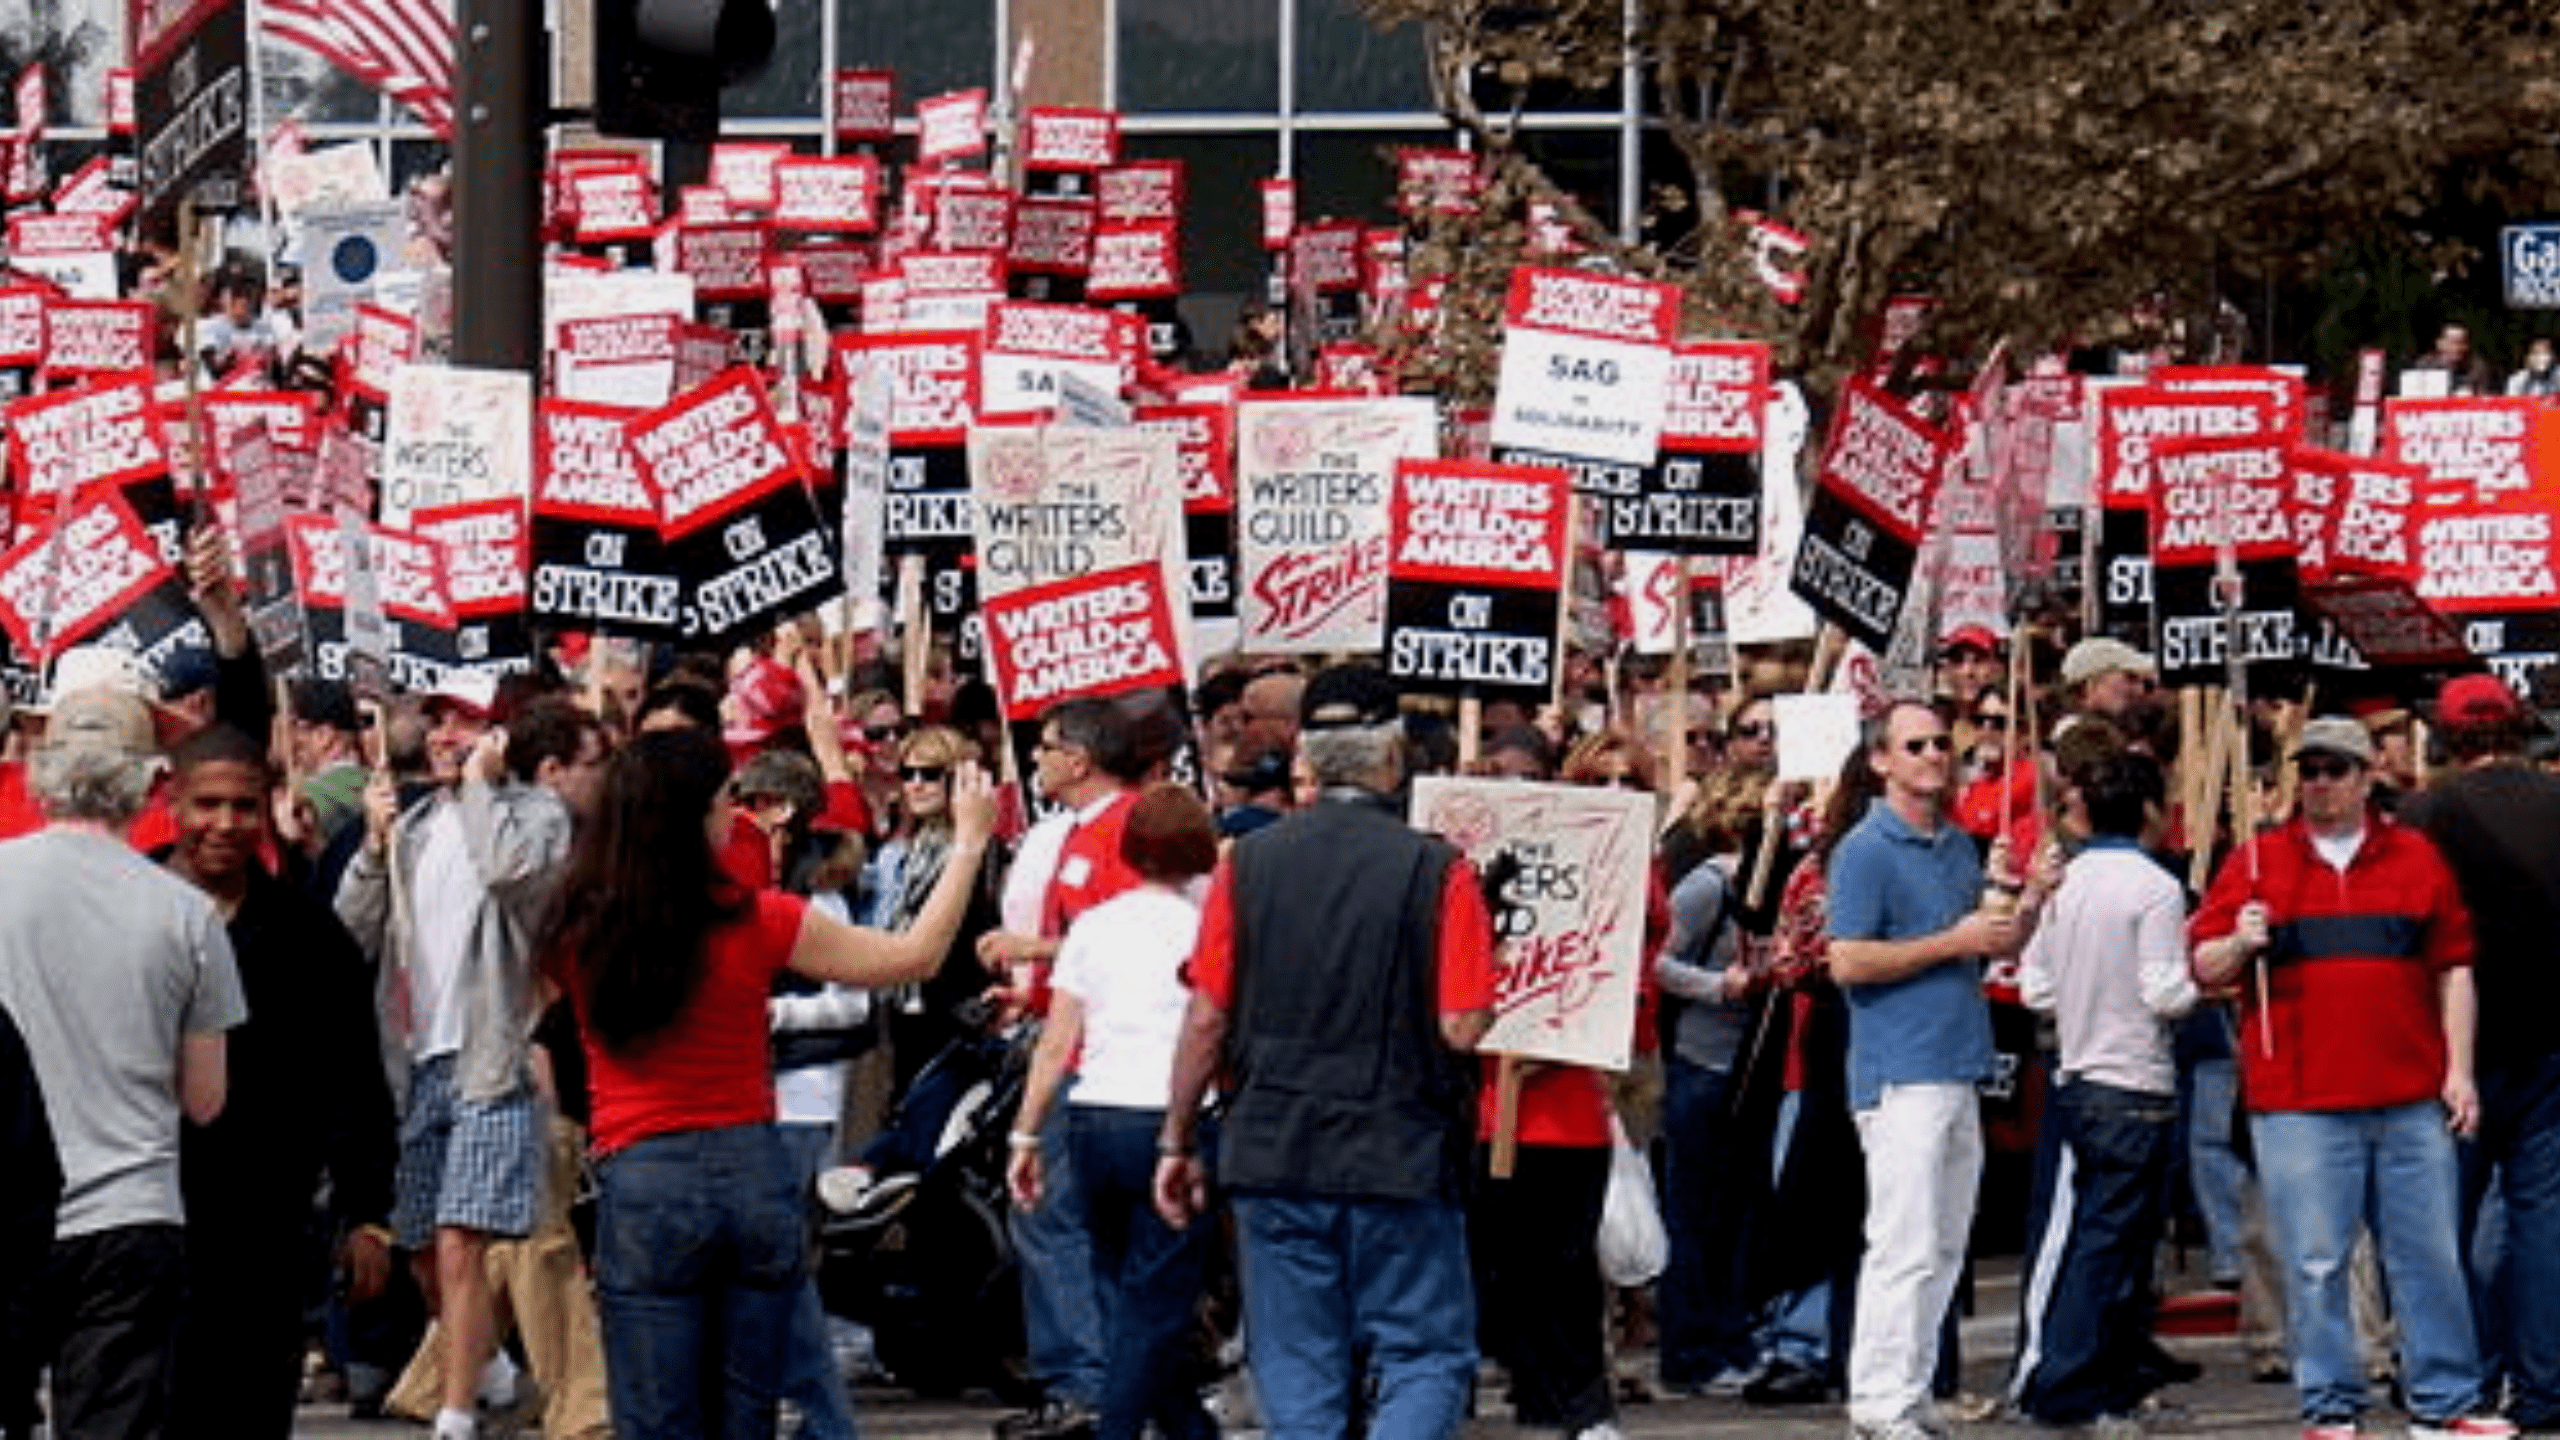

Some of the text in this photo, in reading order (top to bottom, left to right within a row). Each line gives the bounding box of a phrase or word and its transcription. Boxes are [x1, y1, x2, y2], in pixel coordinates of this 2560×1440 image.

[1017, 369, 1055, 392] SA
[1548, 355, 1620, 386] SAG
[634, 384, 757, 462] WRITERS
[2111, 405, 2258, 436] WRITERS
[2396, 409, 2525, 438] WRITERS
[2401, 438, 2487, 465] GUILD
[1250, 472, 1380, 506] WRITERS
[1402, 473, 1551, 514] WRITERS
[1665, 461, 1703, 490] ON
[888, 493, 975, 537] RIKE
[986, 503, 1125, 541] WRITERS
[1249, 508, 1351, 545] GUILD
[1409, 506, 1512, 537] GUILD
[1612, 493, 1754, 541] STRIKE
[2419, 512, 2550, 547] WRITERS
[585, 531, 627, 568] ON
[723, 513, 767, 562] ON
[1399, 535, 1554, 572] AMERICA
[986, 540, 1095, 577] GUILD
[2420, 543, 2516, 571] GUILD
[534, 564, 680, 625] STRIKE
[697, 529, 834, 635] STRIKE
[2417, 567, 2555, 598] AMERICA
[995, 580, 1152, 641] WRITERS
[1450, 594, 1492, 629] ON
[1010, 619, 1113, 671] GUILD
[1391, 628, 1548, 685] STRIKE
[2163, 610, 2294, 670] STRKE
[1012, 640, 1173, 705] AMERICA
